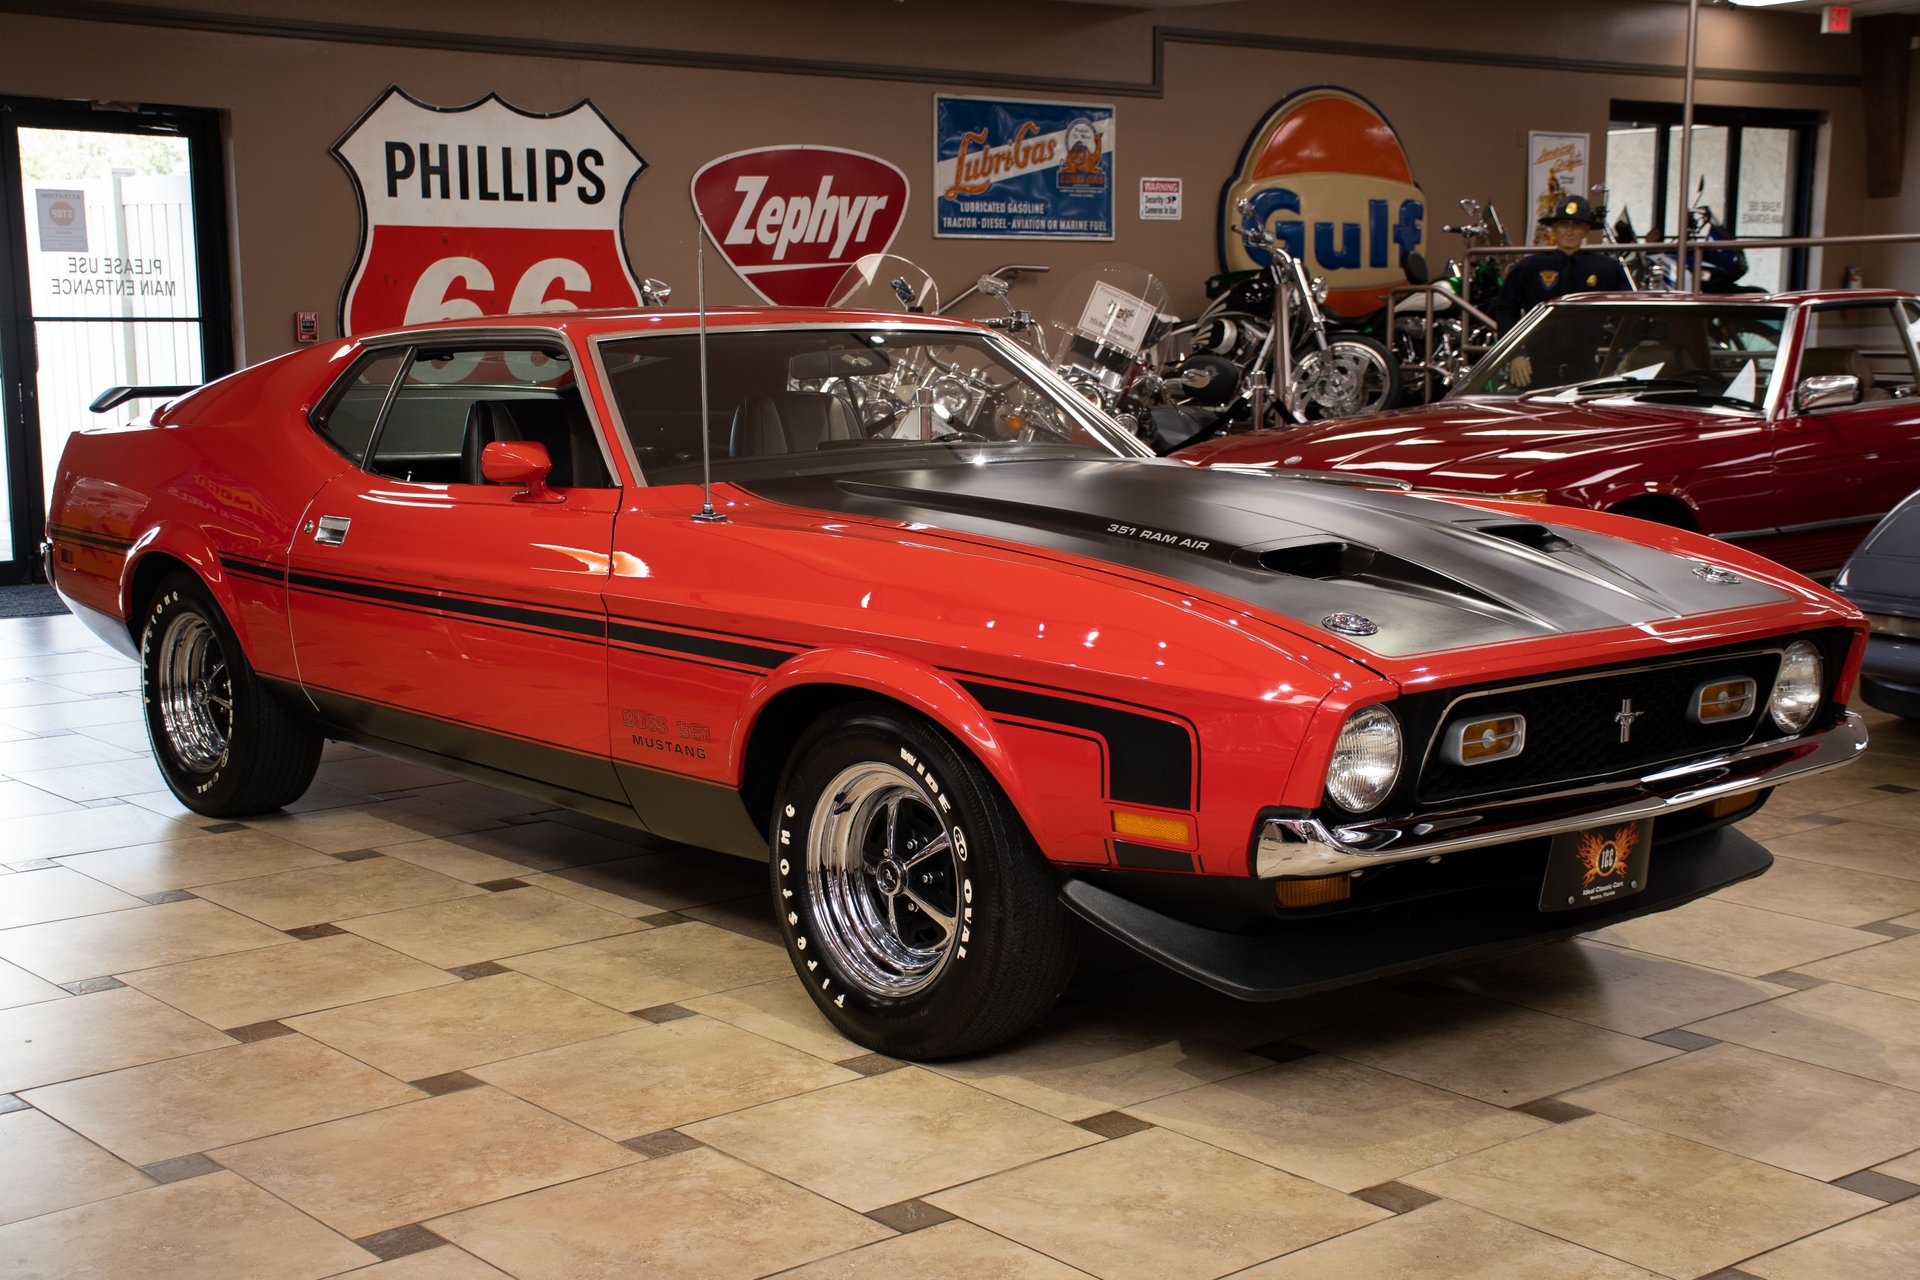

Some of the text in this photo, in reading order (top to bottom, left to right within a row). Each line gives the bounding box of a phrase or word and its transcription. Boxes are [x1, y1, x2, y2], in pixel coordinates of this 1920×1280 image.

[385, 141, 606, 205] PHILLIPS
[1143, 181, 1178, 192] WARNING
[960, 201, 1045, 215] LUBRICATED GASOLINE
[1145, 195, 1163, 206] Security
[723, 175, 889, 261] Zephyr
[943, 217, 1107, 231] TRACTOR DIESEL AVIATION OR MARINE FUEL
[1242, 187, 1424, 270] Gulf
[300, 313, 316, 321] FIRE
[1107, 523, 1210, 551] 351 RAM AIR
[622, 709, 711, 743] BOSS 351
[632, 734, 706, 760] MUSTANG
[900, 747, 951, 814] WIDE
[957, 879, 973, 960] OVAL
[1583, 888, 1596, 896] Ideal
[780, 803, 846, 1009] Firestone
